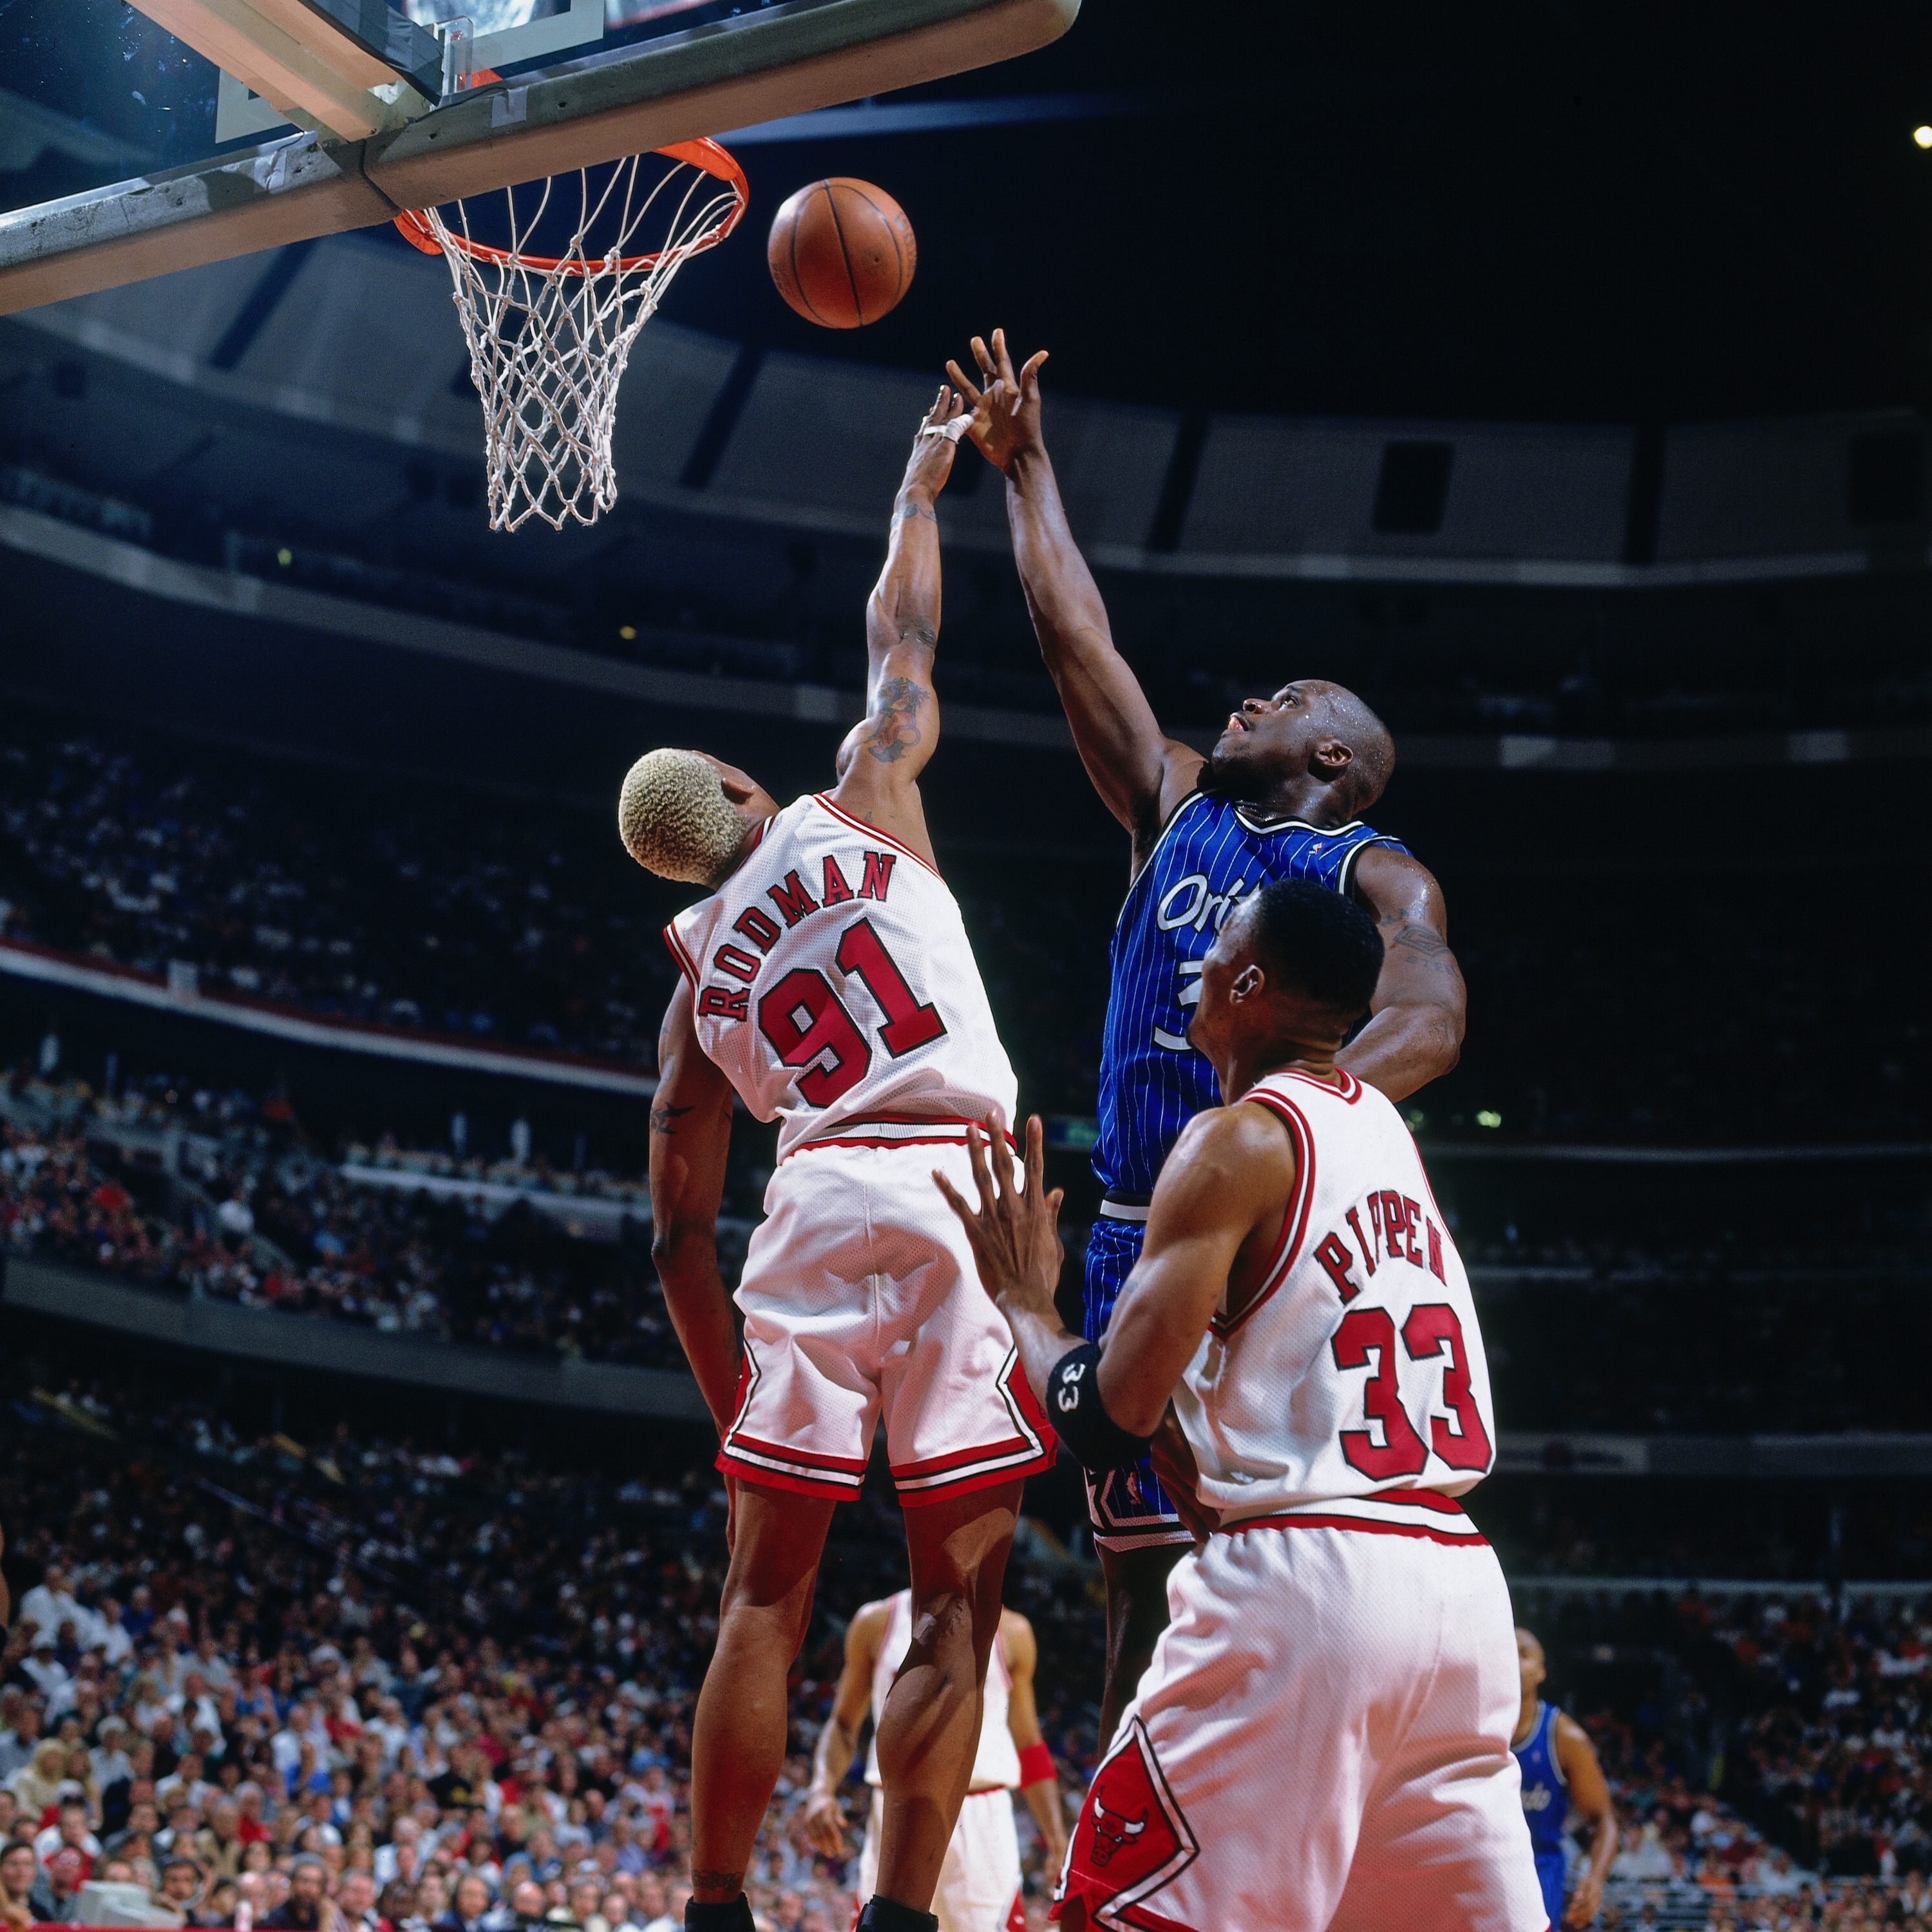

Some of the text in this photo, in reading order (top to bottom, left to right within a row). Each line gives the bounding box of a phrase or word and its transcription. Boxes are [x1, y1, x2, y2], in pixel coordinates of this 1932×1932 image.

[698, 850, 896, 1022] RODMAN
[758, 916, 948, 1108] 91
[1314, 1190, 1448, 1306] PIPPEN
[1057, 1363, 1086, 1412] 33
[1331, 1303, 1492, 1482] 33
